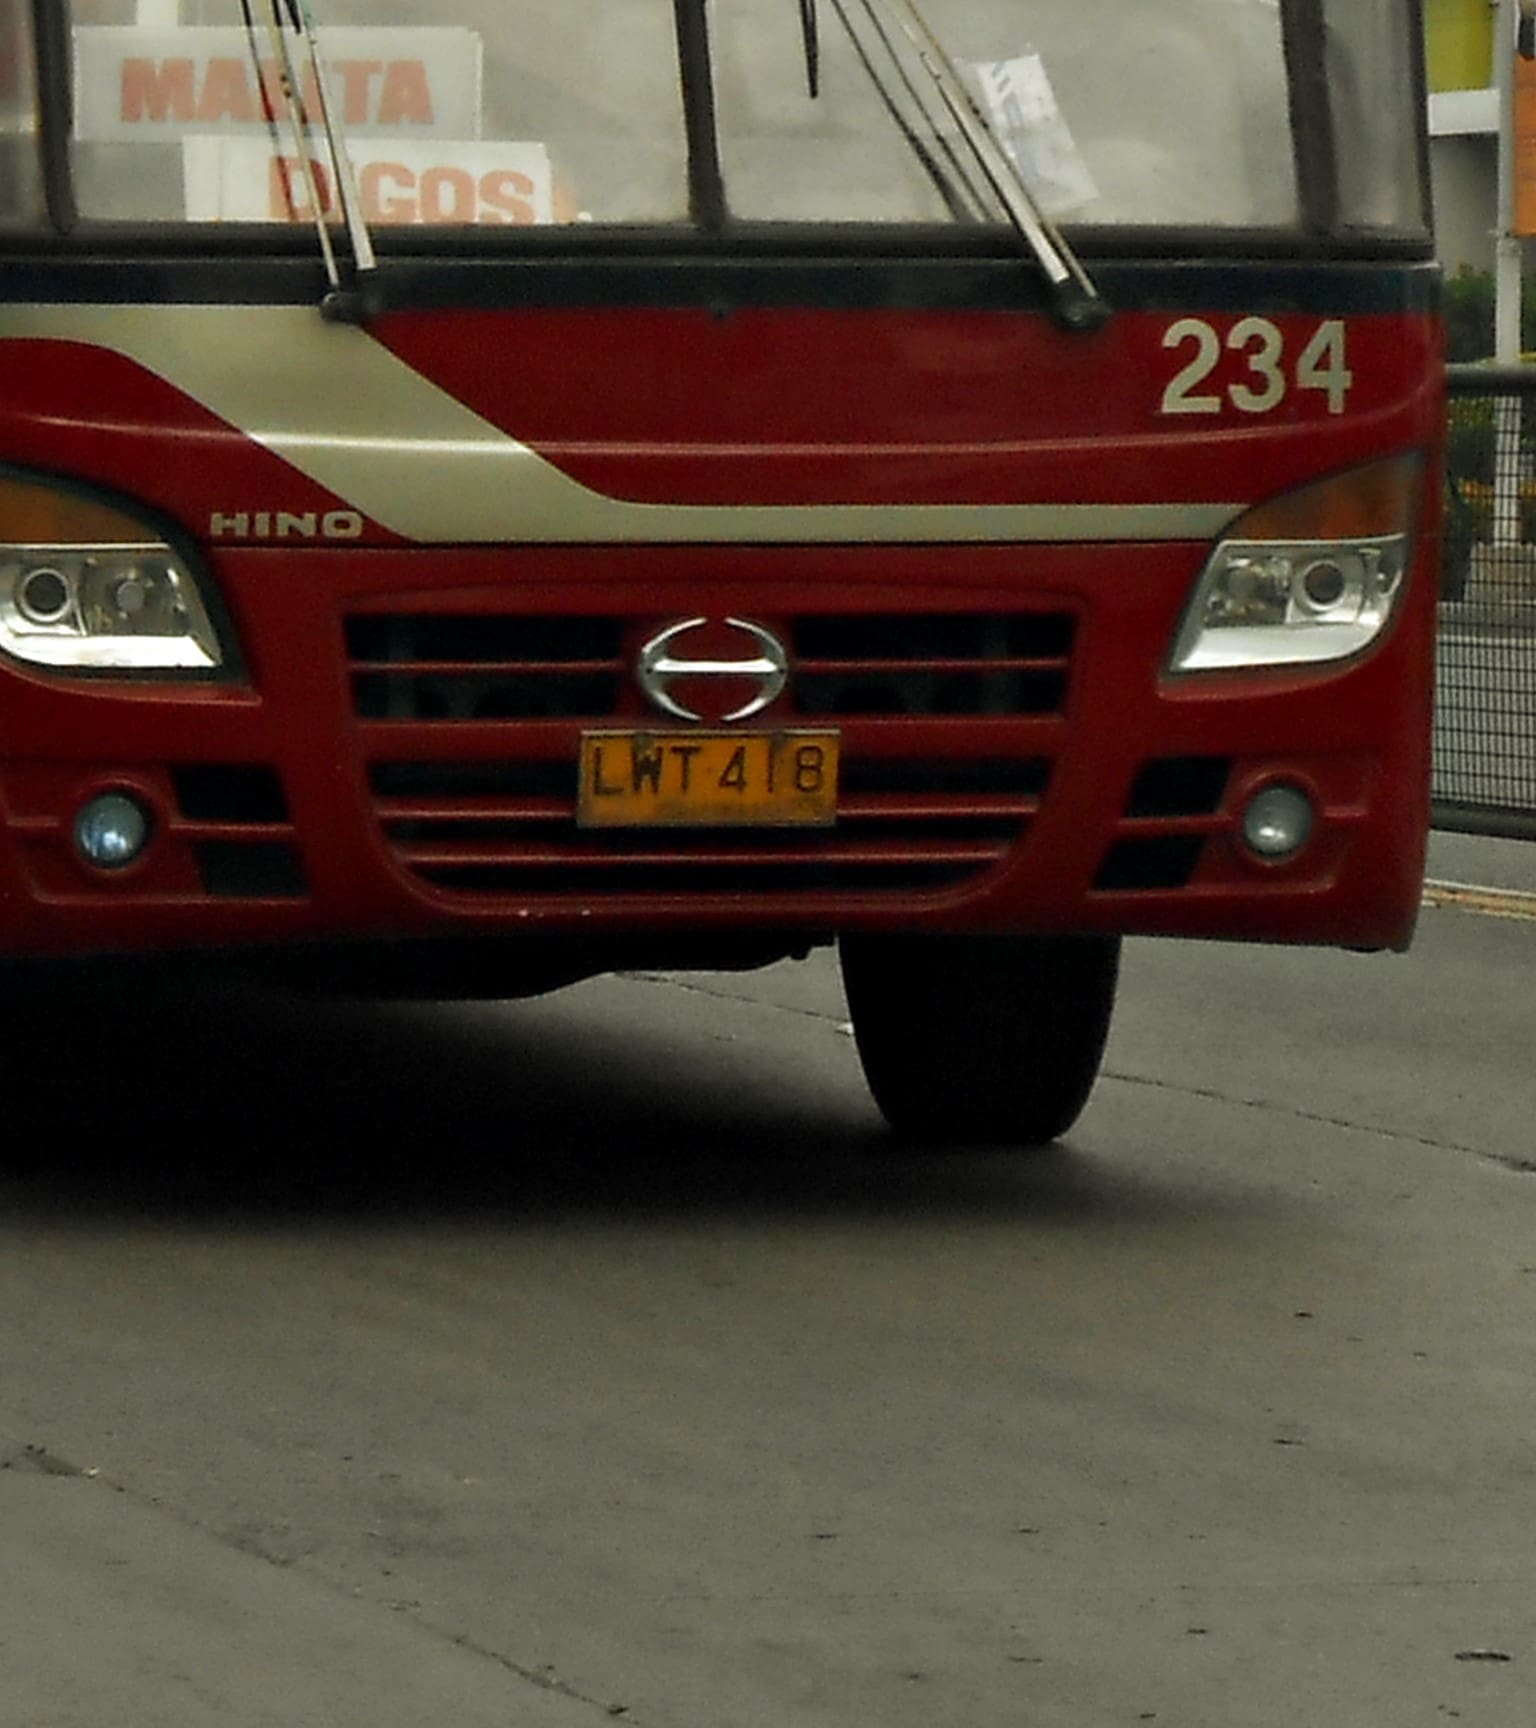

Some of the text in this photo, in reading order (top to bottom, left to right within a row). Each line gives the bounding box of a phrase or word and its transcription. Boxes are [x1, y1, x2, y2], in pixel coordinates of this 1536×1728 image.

[269, 155, 535, 225] DGOS
[1162, 316, 1352, 414] 234
[210, 510, 363, 538] HINO
